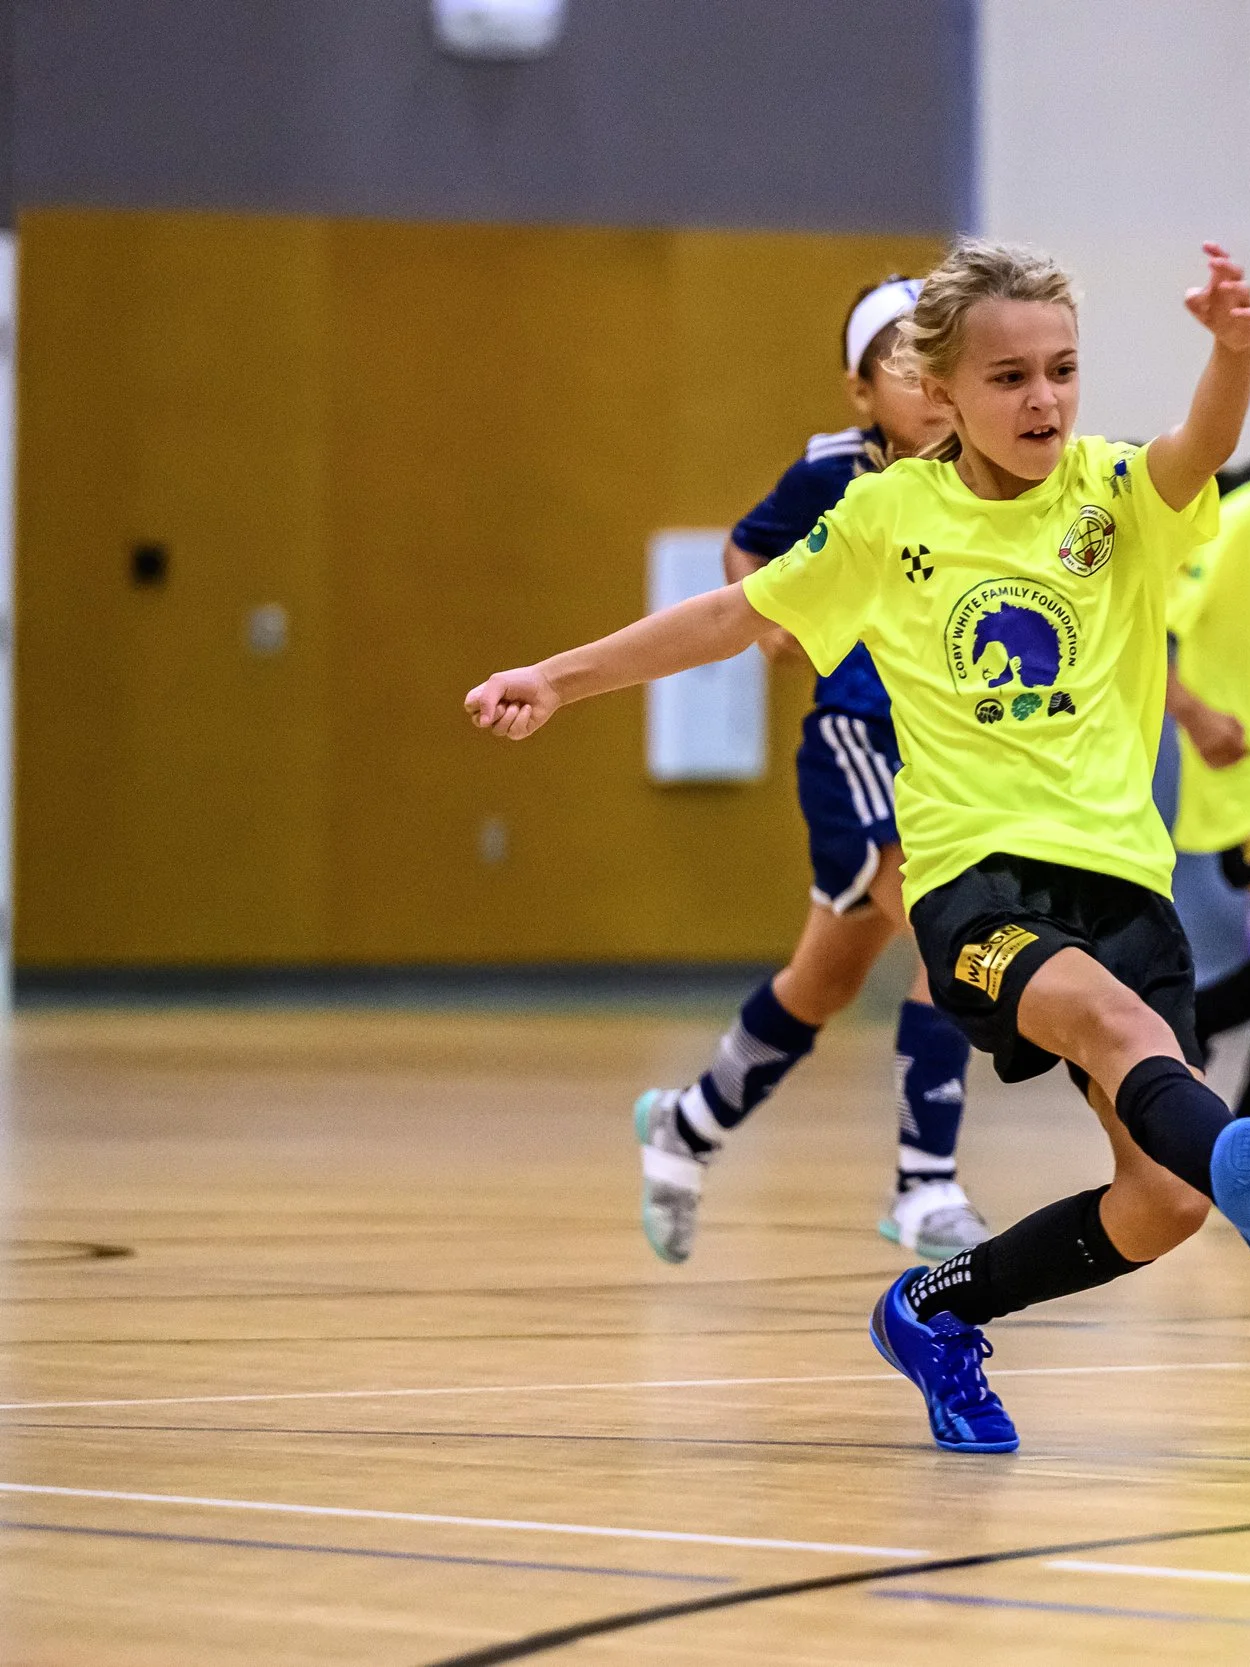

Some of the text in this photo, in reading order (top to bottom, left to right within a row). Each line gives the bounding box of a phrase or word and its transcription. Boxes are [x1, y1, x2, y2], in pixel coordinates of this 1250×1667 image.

[953, 586, 1077, 679] COBY WHITE FAMILY FOUNDATION
